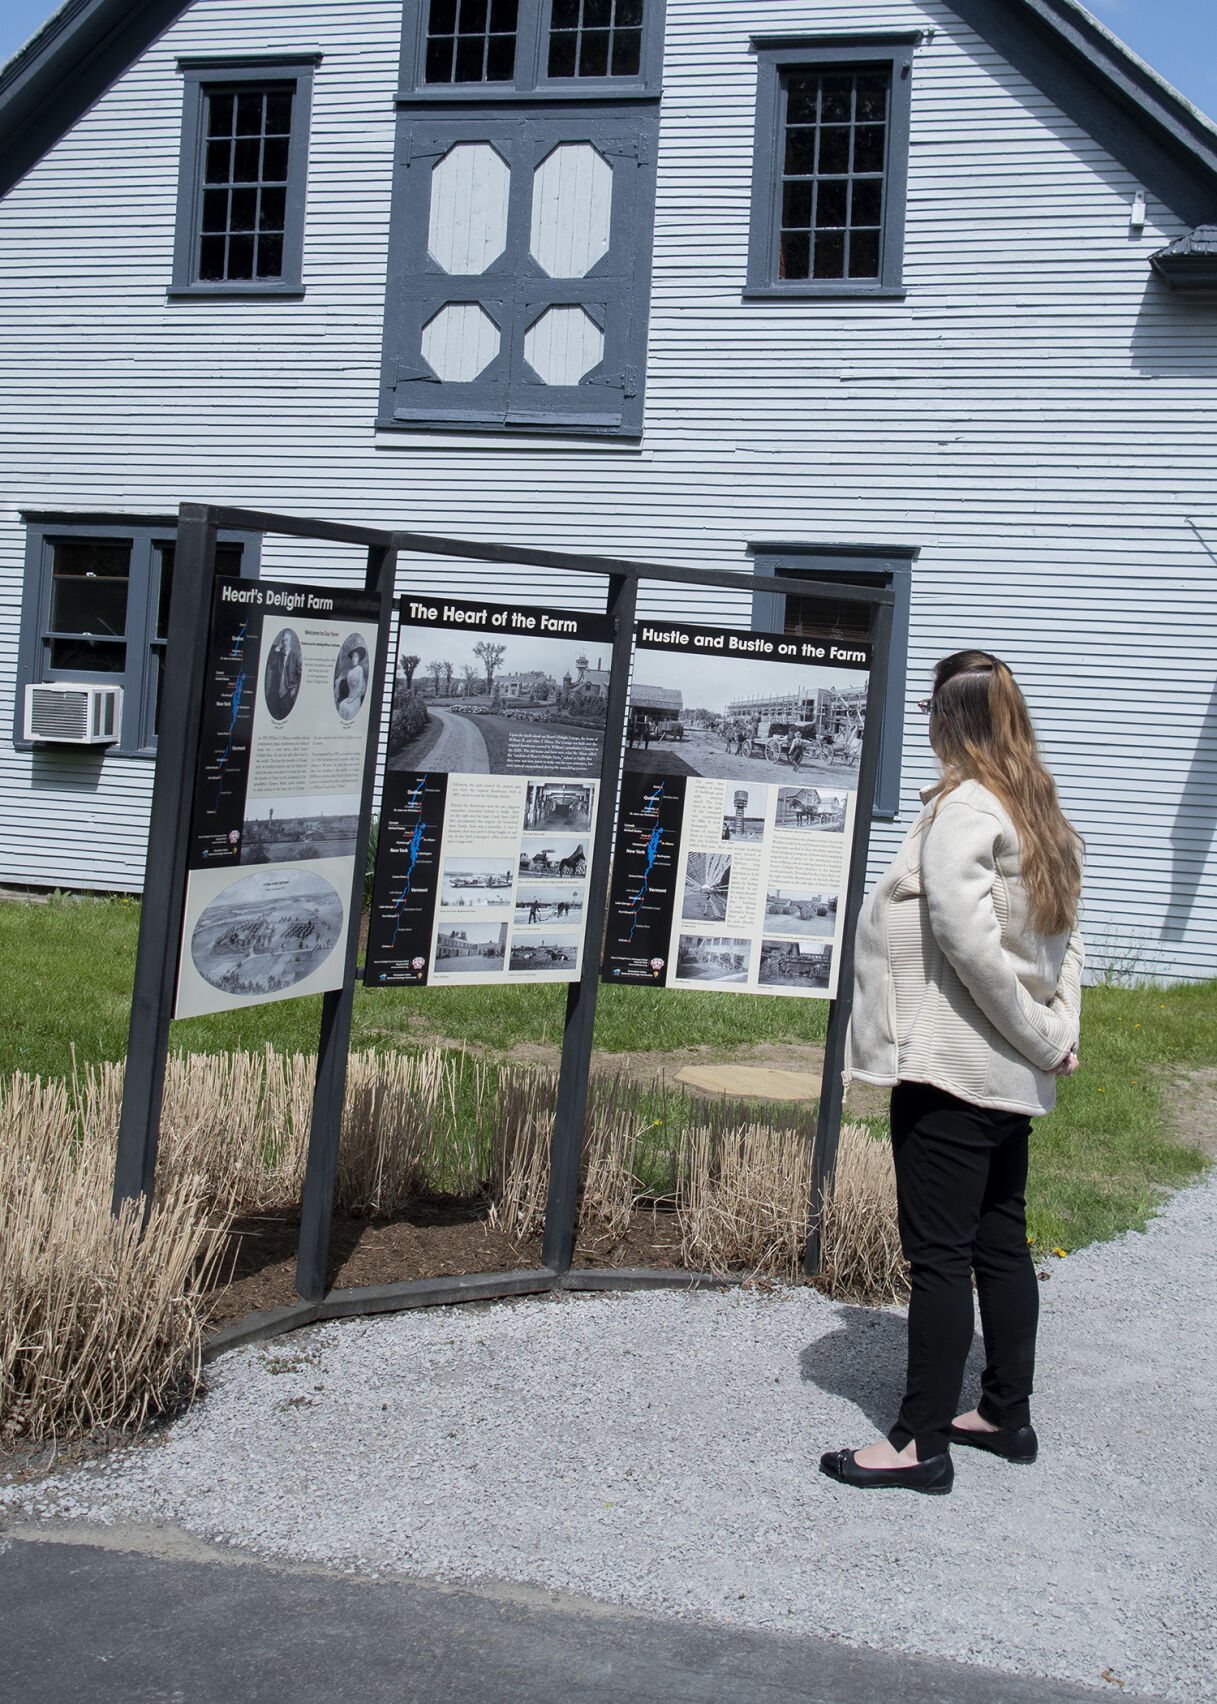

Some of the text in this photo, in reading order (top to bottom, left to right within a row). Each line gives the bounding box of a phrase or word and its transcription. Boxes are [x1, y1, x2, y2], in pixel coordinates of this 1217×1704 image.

[222, 586, 333, 611] Heart's Delight Farm
[409, 603, 578, 633] The Heart of the Farm
[642, 628, 866, 663] Hustle and Bustle on the Farm
